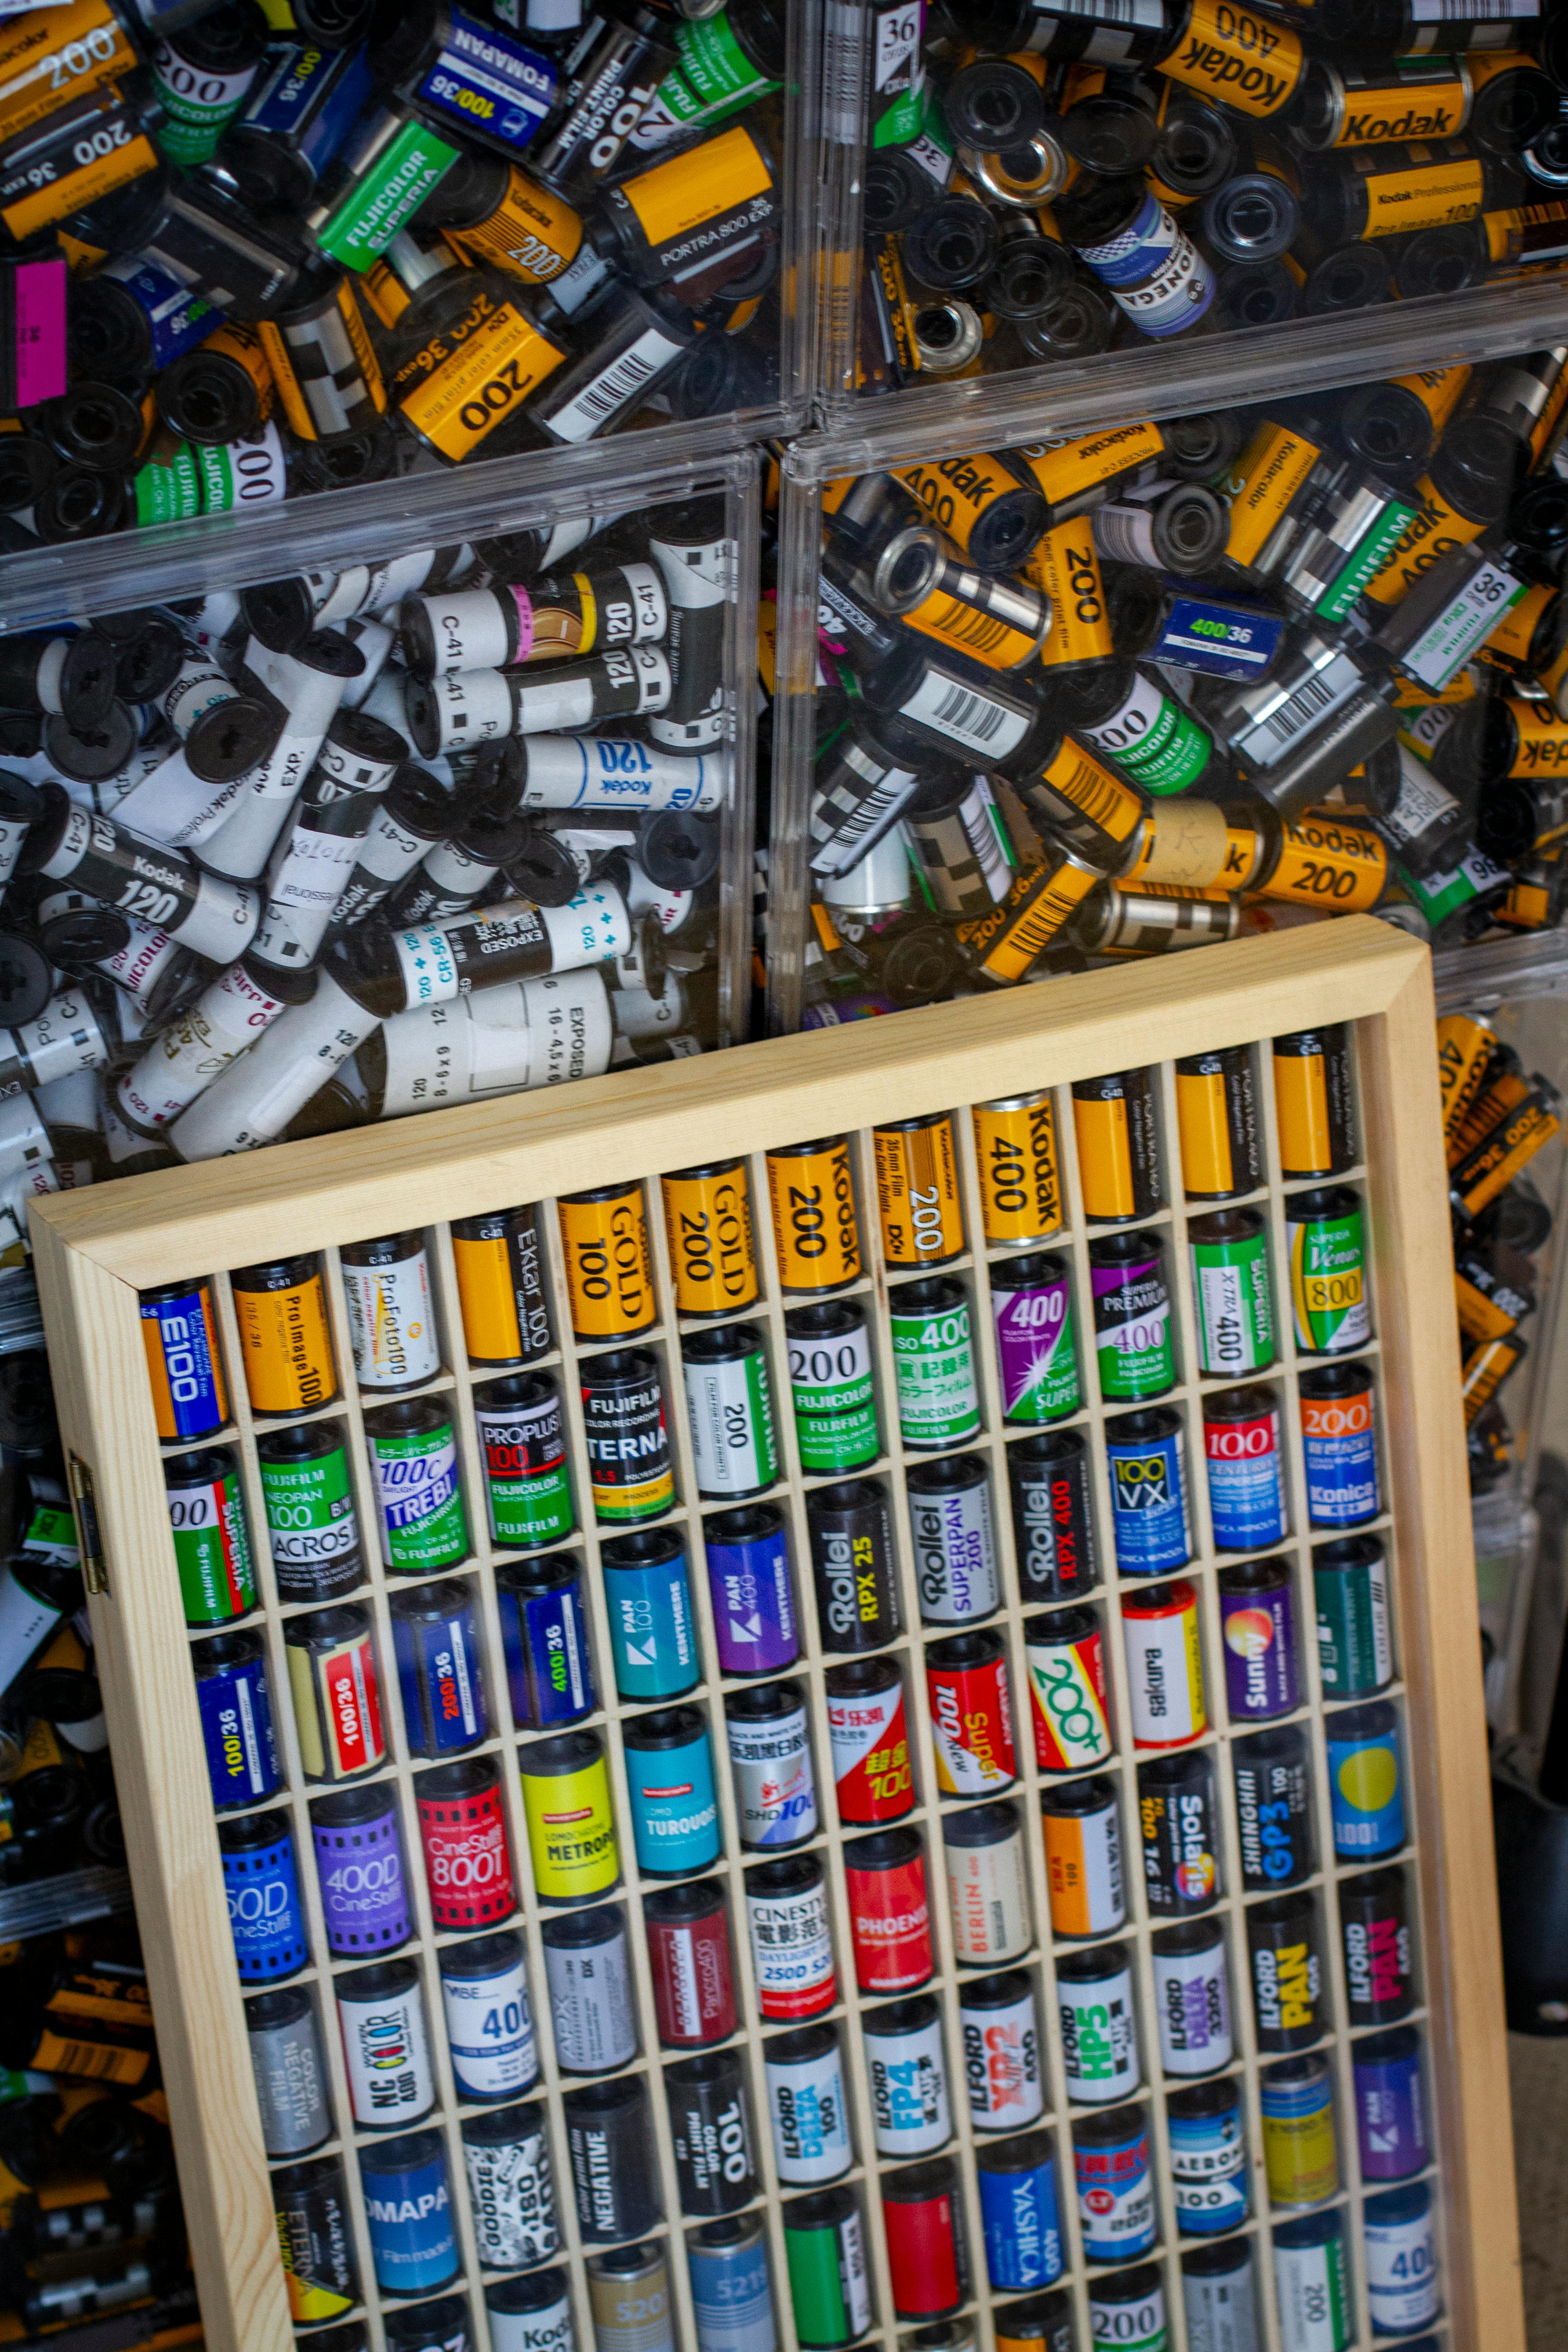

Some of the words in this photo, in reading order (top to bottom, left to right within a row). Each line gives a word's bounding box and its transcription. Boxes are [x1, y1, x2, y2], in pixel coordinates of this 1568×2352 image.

[884, 12, 916, 48] 36
[1215, 5, 1281, 58] 400
[455, 29, 549, 91] FOMAPAN
[1180, 36, 1288, 107] Kodak
[430, 76, 495, 118] 100/36
[582, 85, 625, 140] COLOR
[590, 84, 657, 168] 100
[1341, 107, 1456, 142] Kodak
[346, 151, 428, 247] FUJICOLOR
[1378, 190, 1414, 205] Kodak
[661, 230, 720, 266] PORTRA
[460, 359, 533, 431] 200
[1247, 440, 1297, 510] Kodacolor
[1066, 547, 1100, 624] 200
[1332, 513, 1411, 613] FUJIFILM
[642, 584, 657, 626] C-41
[1474, 573, 1505, 601] 36
[441, 616, 462, 658] C-41
[606, 602, 632, 642] 120
[1190, 618, 1253, 644] 400/36
[602, 650, 636, 689] 120
[642, 644, 657, 669] C-4
[598, 741, 653, 774] 120
[602, 779, 652, 794] Kodak
[66, 813, 87, 853] C-41
[378, 821, 416, 853] C-41
[1288, 825, 1379, 861] Kodak
[134, 858, 185, 890] Kodak
[1291, 862, 1357, 898] 200
[117, 881, 179, 923] 120
[480, 930, 543, 953] EXPOSED
[581, 926, 596, 951] 120
[408, 933, 421, 951] 120
[420, 977, 432, 998] 120
[569, 1007, 584, 1078] EXPOSED
[412, 1078, 426, 1099] 120
[886, 1139, 900, 1173] 35mm
[989, 1136, 1027, 1213] 400
[1028, 1106, 1058, 1226] Kodak
[892, 1176, 905, 1197] Film
[789, 1185, 826, 1259] 200
[832, 1150, 858, 1274] Kodak
[910, 1186, 943, 1251] 200
[518, 1228, 542, 1298] Ektar
[610, 1205, 643, 1319] GOLD
[681, 1211, 715, 1283] 200
[714, 1184, 746, 1297] GOLD
[1311, 1245, 1361, 1270] Venus
[577, 1237, 611, 1301] 100
[1313, 1276, 1358, 1306] 800
[286, 1295, 301, 1318] Pro
[527, 1304, 550, 1348] 100
[1011, 1291, 1063, 1328] 400
[921, 1312, 969, 1348] 400
[1114, 1321, 1164, 1353] 400
[1219, 1316, 1242, 1361] 400
[161, 1315, 199, 1402] E100
[790, 1346, 856, 1382] 200
[591, 1385, 660, 1413] FUJIFILM
[797, 1383, 872, 1408] FUJICOLOR
[724, 1402, 748, 1448] 200
[810, 1414, 867, 1432] FUJIFILM
[1306, 1405, 1366, 1434] 200
[486, 1445, 528, 1468] 100
[1209, 1429, 1268, 1457] 100
[1116, 1458, 1165, 1483] 100
[1310, 1483, 1373, 1502] Konica
[268, 1490, 323, 1502] NEOPAN
[271, 1506, 312, 1528] 100
[391, 1474, 453, 1524] TREBI
[1051, 1480, 1071, 1524] 400
[1119, 1481, 1166, 1508] VX
[223, 1501, 241, 1591] SUPERIA
[497, 1516, 559, 1534] FUJIFILM
[1021, 1481, 1053, 1583] Rollei
[852, 1537, 873, 1567] 25
[916, 1505, 946, 1605] Rollei
[945, 1498, 971, 1613] SUPERPAN
[965, 1530, 984, 1572] 200
[1056, 1532, 1077, 1580] RPX
[725, 1576, 740, 1610] PAN
[773, 1555, 791, 1641] KENTMERE
[822, 1532, 856, 1634] Rollei
[857, 1573, 879, 1622] RPX
[620, 1600, 637, 1632] PAN
[634, 1600, 652, 1631] 100
[669, 1581, 689, 1666] KENTMERE
[546, 1625, 566, 1692] 400/36
[1245, 1631, 1269, 1707] Sunny
[435, 1652, 458, 1720] 200/36
[1145, 1647, 1166, 1719] sakura
[335, 1678, 359, 1746] 100/36
[936, 1684, 961, 1740] 100
[219, 1709, 244, 1777] 100/36
[963, 1713, 999, 1780] Super
[870, 1764, 911, 1800] 100
[1272, 1767, 1286, 1793] 100
[745, 1809, 779, 1821] SHD
[1237, 1770, 1262, 1876] SHANGHAI
[428, 1825, 503, 1855] CineStill
[1180, 1794, 1206, 1897] Solaris
[1259, 1802, 1294, 1880] GP3
[327, 1854, 399, 1892] 400D
[433, 1845, 504, 1885] 800T
[330, 1882, 402, 1912] CineStill
[966, 1884, 988, 1953] BERLIN
[581, 1959, 595, 1978] DX
[765, 1966, 806, 1980] 250D
[1345, 1922, 1372, 2003] ILFORD
[1367, 1918, 1402, 2001] PAN
[1207, 1978, 1222, 2035] 3200
[1254, 1949, 1282, 2030] ILFORD
[1277, 1943, 1313, 2029] PAN
[1167, 1978, 1188, 2049] ILFORD
[1185, 1976, 1209, 2049] DELTA
[1022, 2031, 1037, 2082] 400
[1060, 2004, 1080, 2079] ILFORD
[1076, 2004, 1113, 2080] HP5
[283, 2042, 311, 2131] NEGATIVE
[963, 2024, 990, 2112] ILFORD
[985, 2023, 1025, 2111] XP2
[269, 2071, 289, 2112] FILM
[872, 2059, 892, 2130] ILFORD
[888, 2060, 924, 2131] FP4
[777, 2085, 801, 2160] ILFORD
[796, 2084, 823, 2158] DELTA
[819, 2095, 836, 2136] 100
[702, 2125, 722, 2173] COLOR
[718, 2100, 747, 2183] 100
[587, 2131, 616, 2231] NEGATIVE
[694, 2153, 710, 2189] FILM
[1012, 2178, 1039, 2284] YASHICA
[1095, 2306, 1156, 2338] 200
[1305, 2283, 1324, 2322] 200
